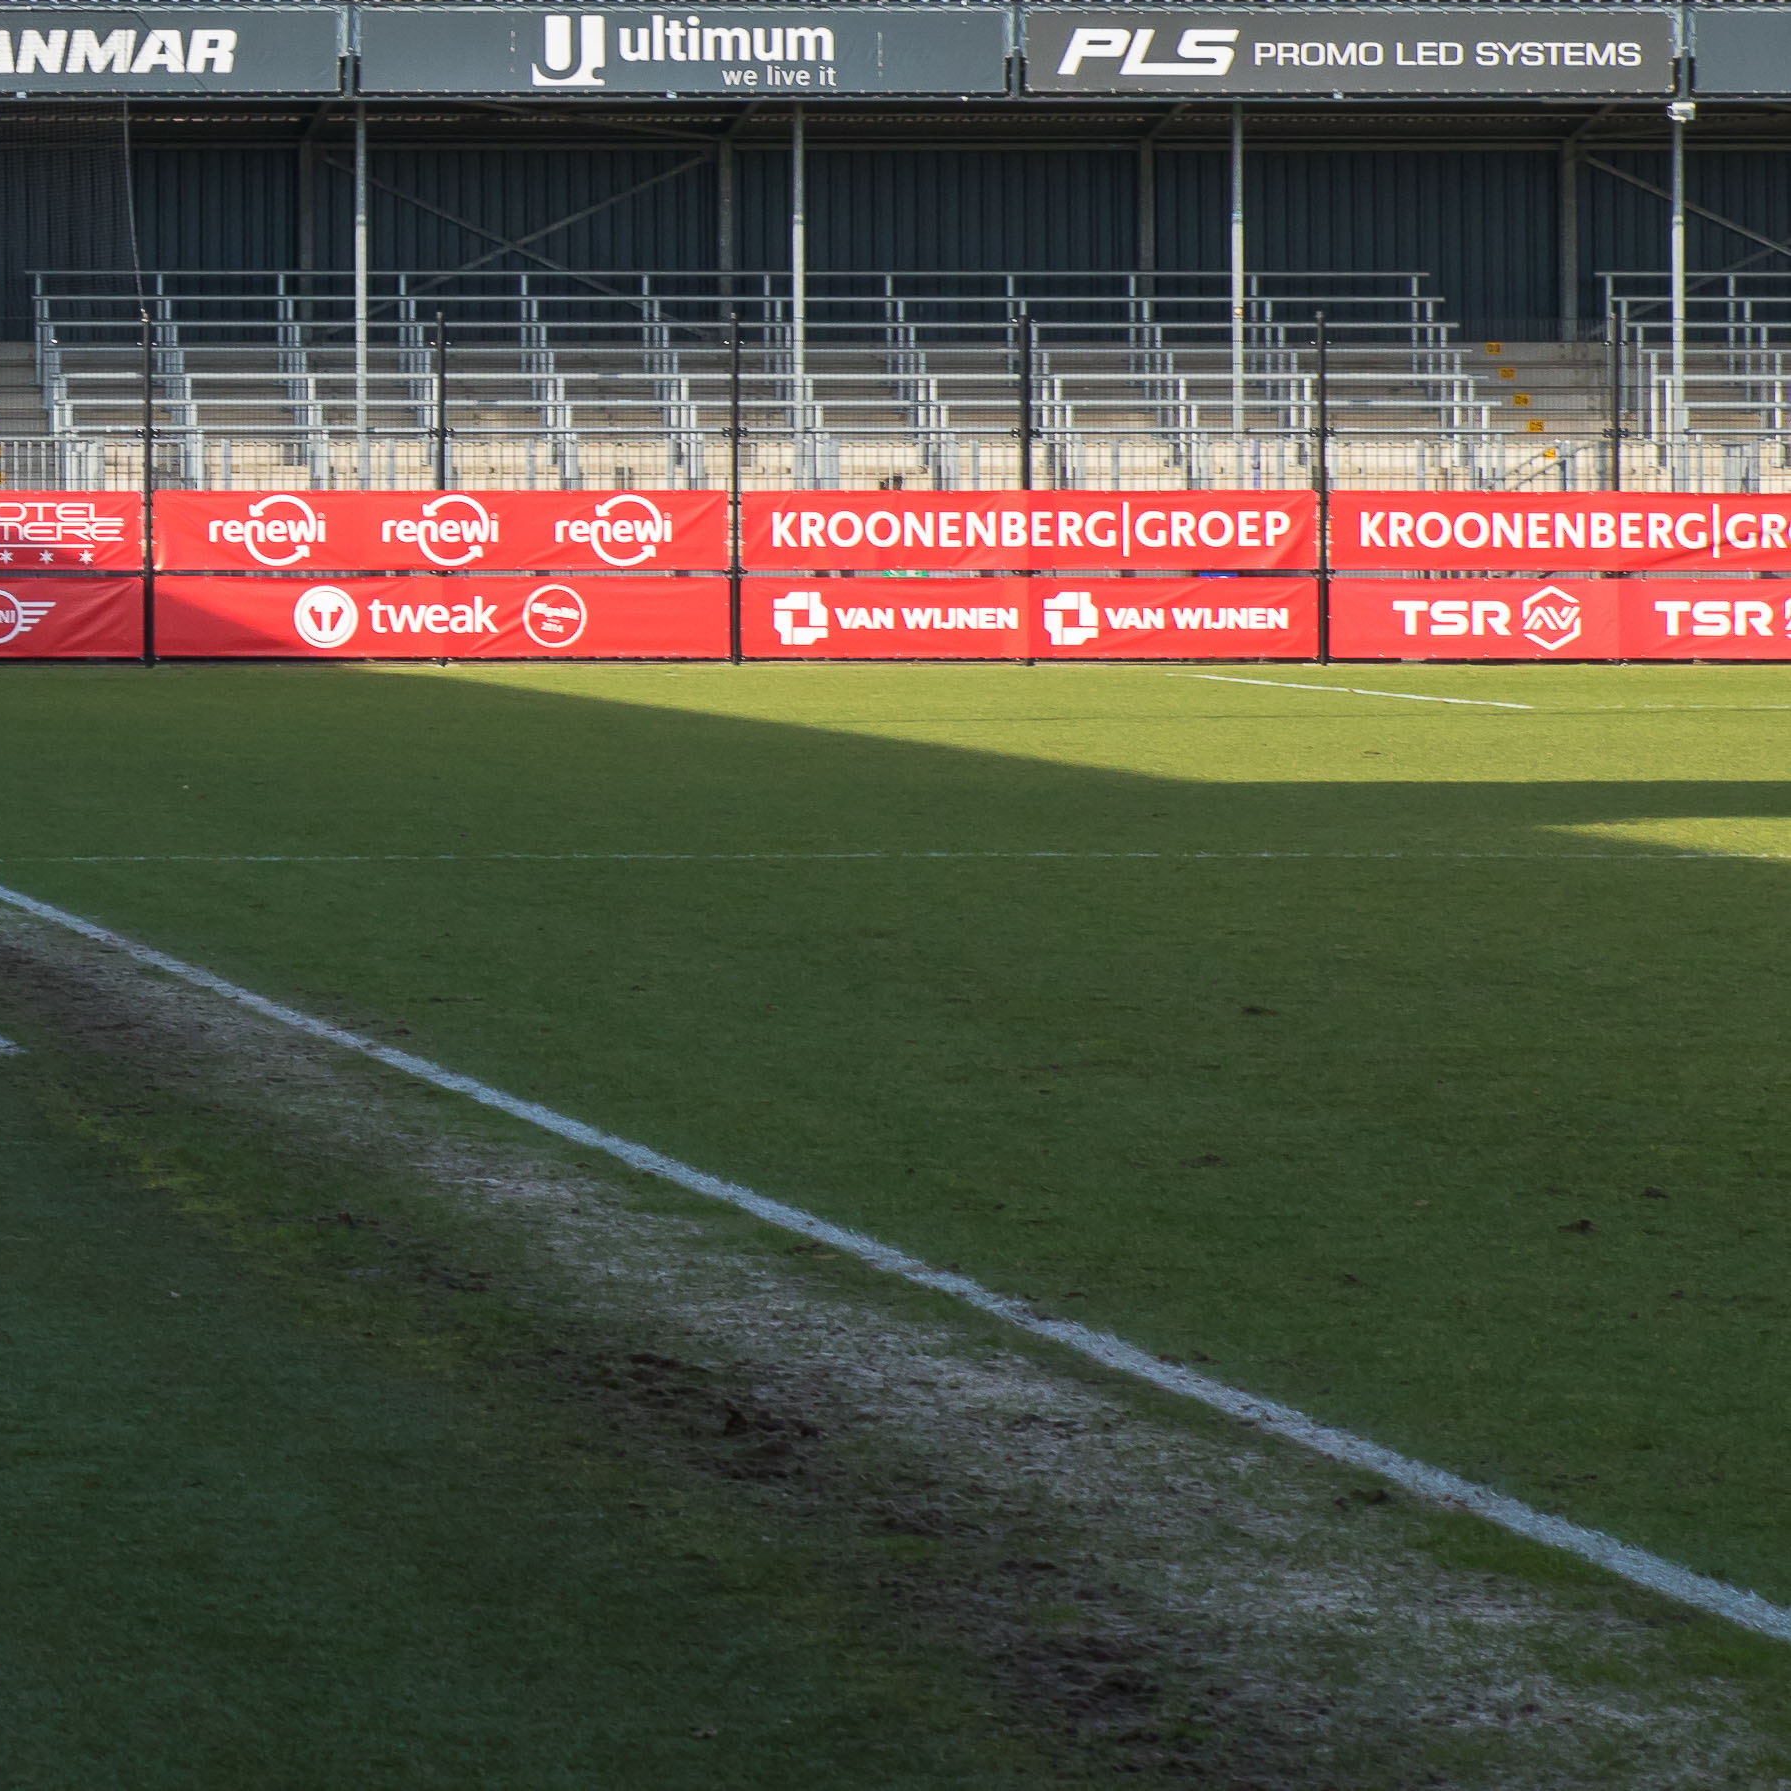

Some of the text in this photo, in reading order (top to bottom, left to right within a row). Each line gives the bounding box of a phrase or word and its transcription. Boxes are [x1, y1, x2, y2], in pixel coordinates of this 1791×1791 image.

[618, 14, 835, 61] ultimum
[1057, 29, 1642, 76] PLS PROMO LED SYSTEMS
[721, 65, 837, 86] we live it
[208, 514, 327, 544] renewi
[381, 514, 500, 544] renewi
[554, 514, 673, 544] renewi
[367, 595, 500, 634] tweak
[838, 607, 1018, 630] VAN WIJNEN
[1105, 607, 1288, 630] VAN WIJNEN
[1392, 600, 1511, 636] TSR
[1654, 600, 1774, 636] TSR
